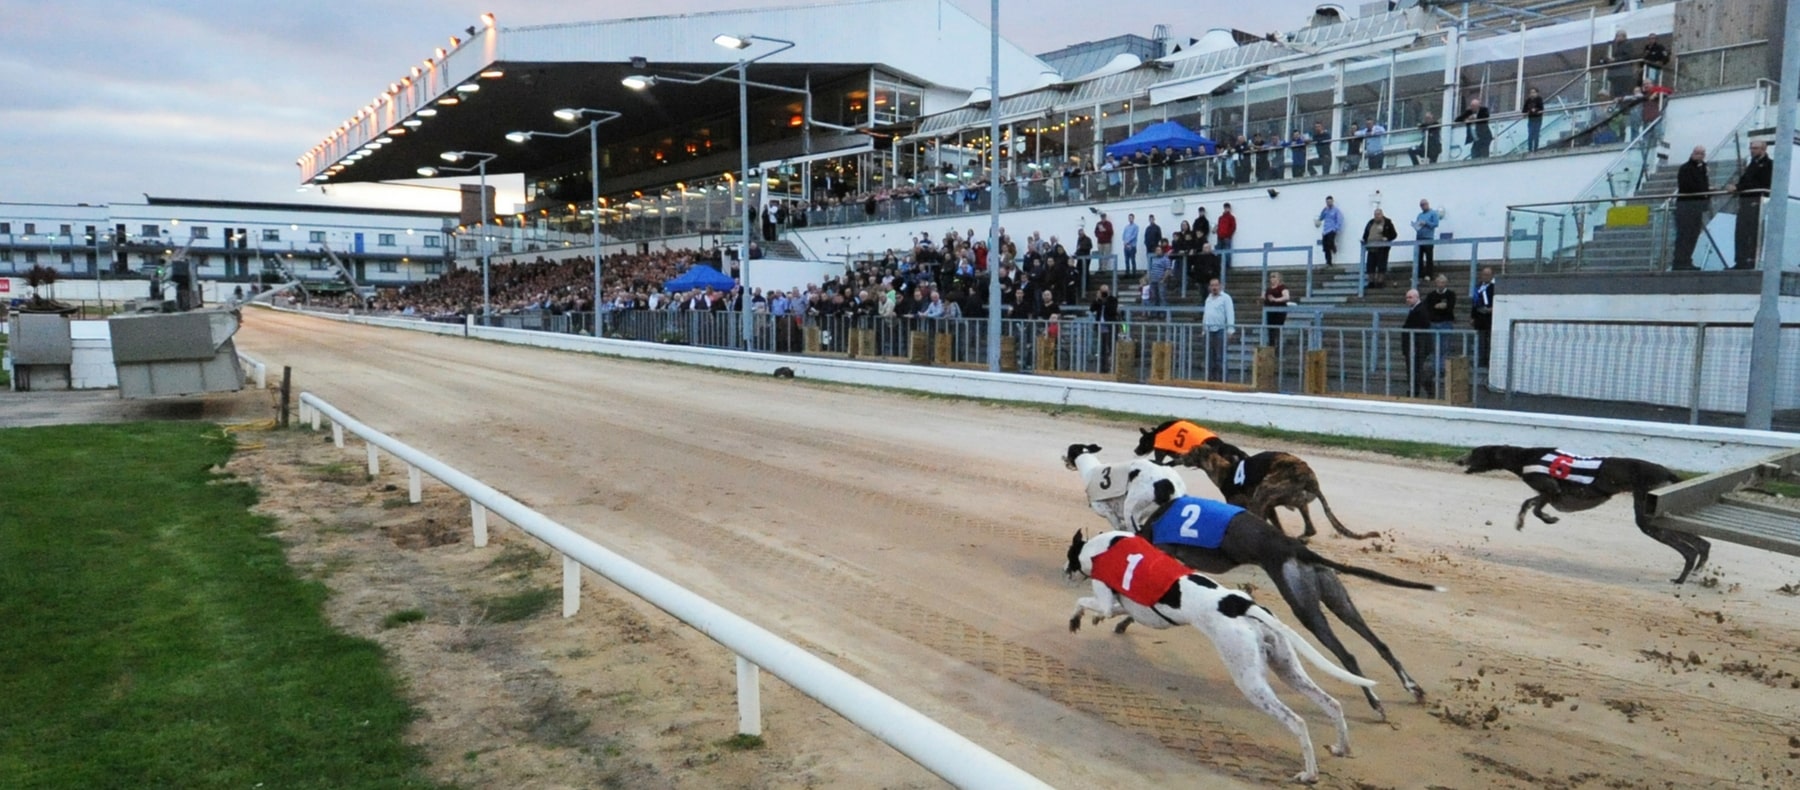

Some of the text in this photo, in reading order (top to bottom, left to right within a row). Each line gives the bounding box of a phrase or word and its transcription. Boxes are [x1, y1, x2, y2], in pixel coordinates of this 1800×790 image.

[1173, 428, 1189, 448] 5
[1099, 467, 1112, 490] 3
[1234, 460, 1246, 486] 4
[1549, 455, 1574, 479] 6
[1179, 504, 1201, 538] 2
[1121, 553, 1144, 591] 1
